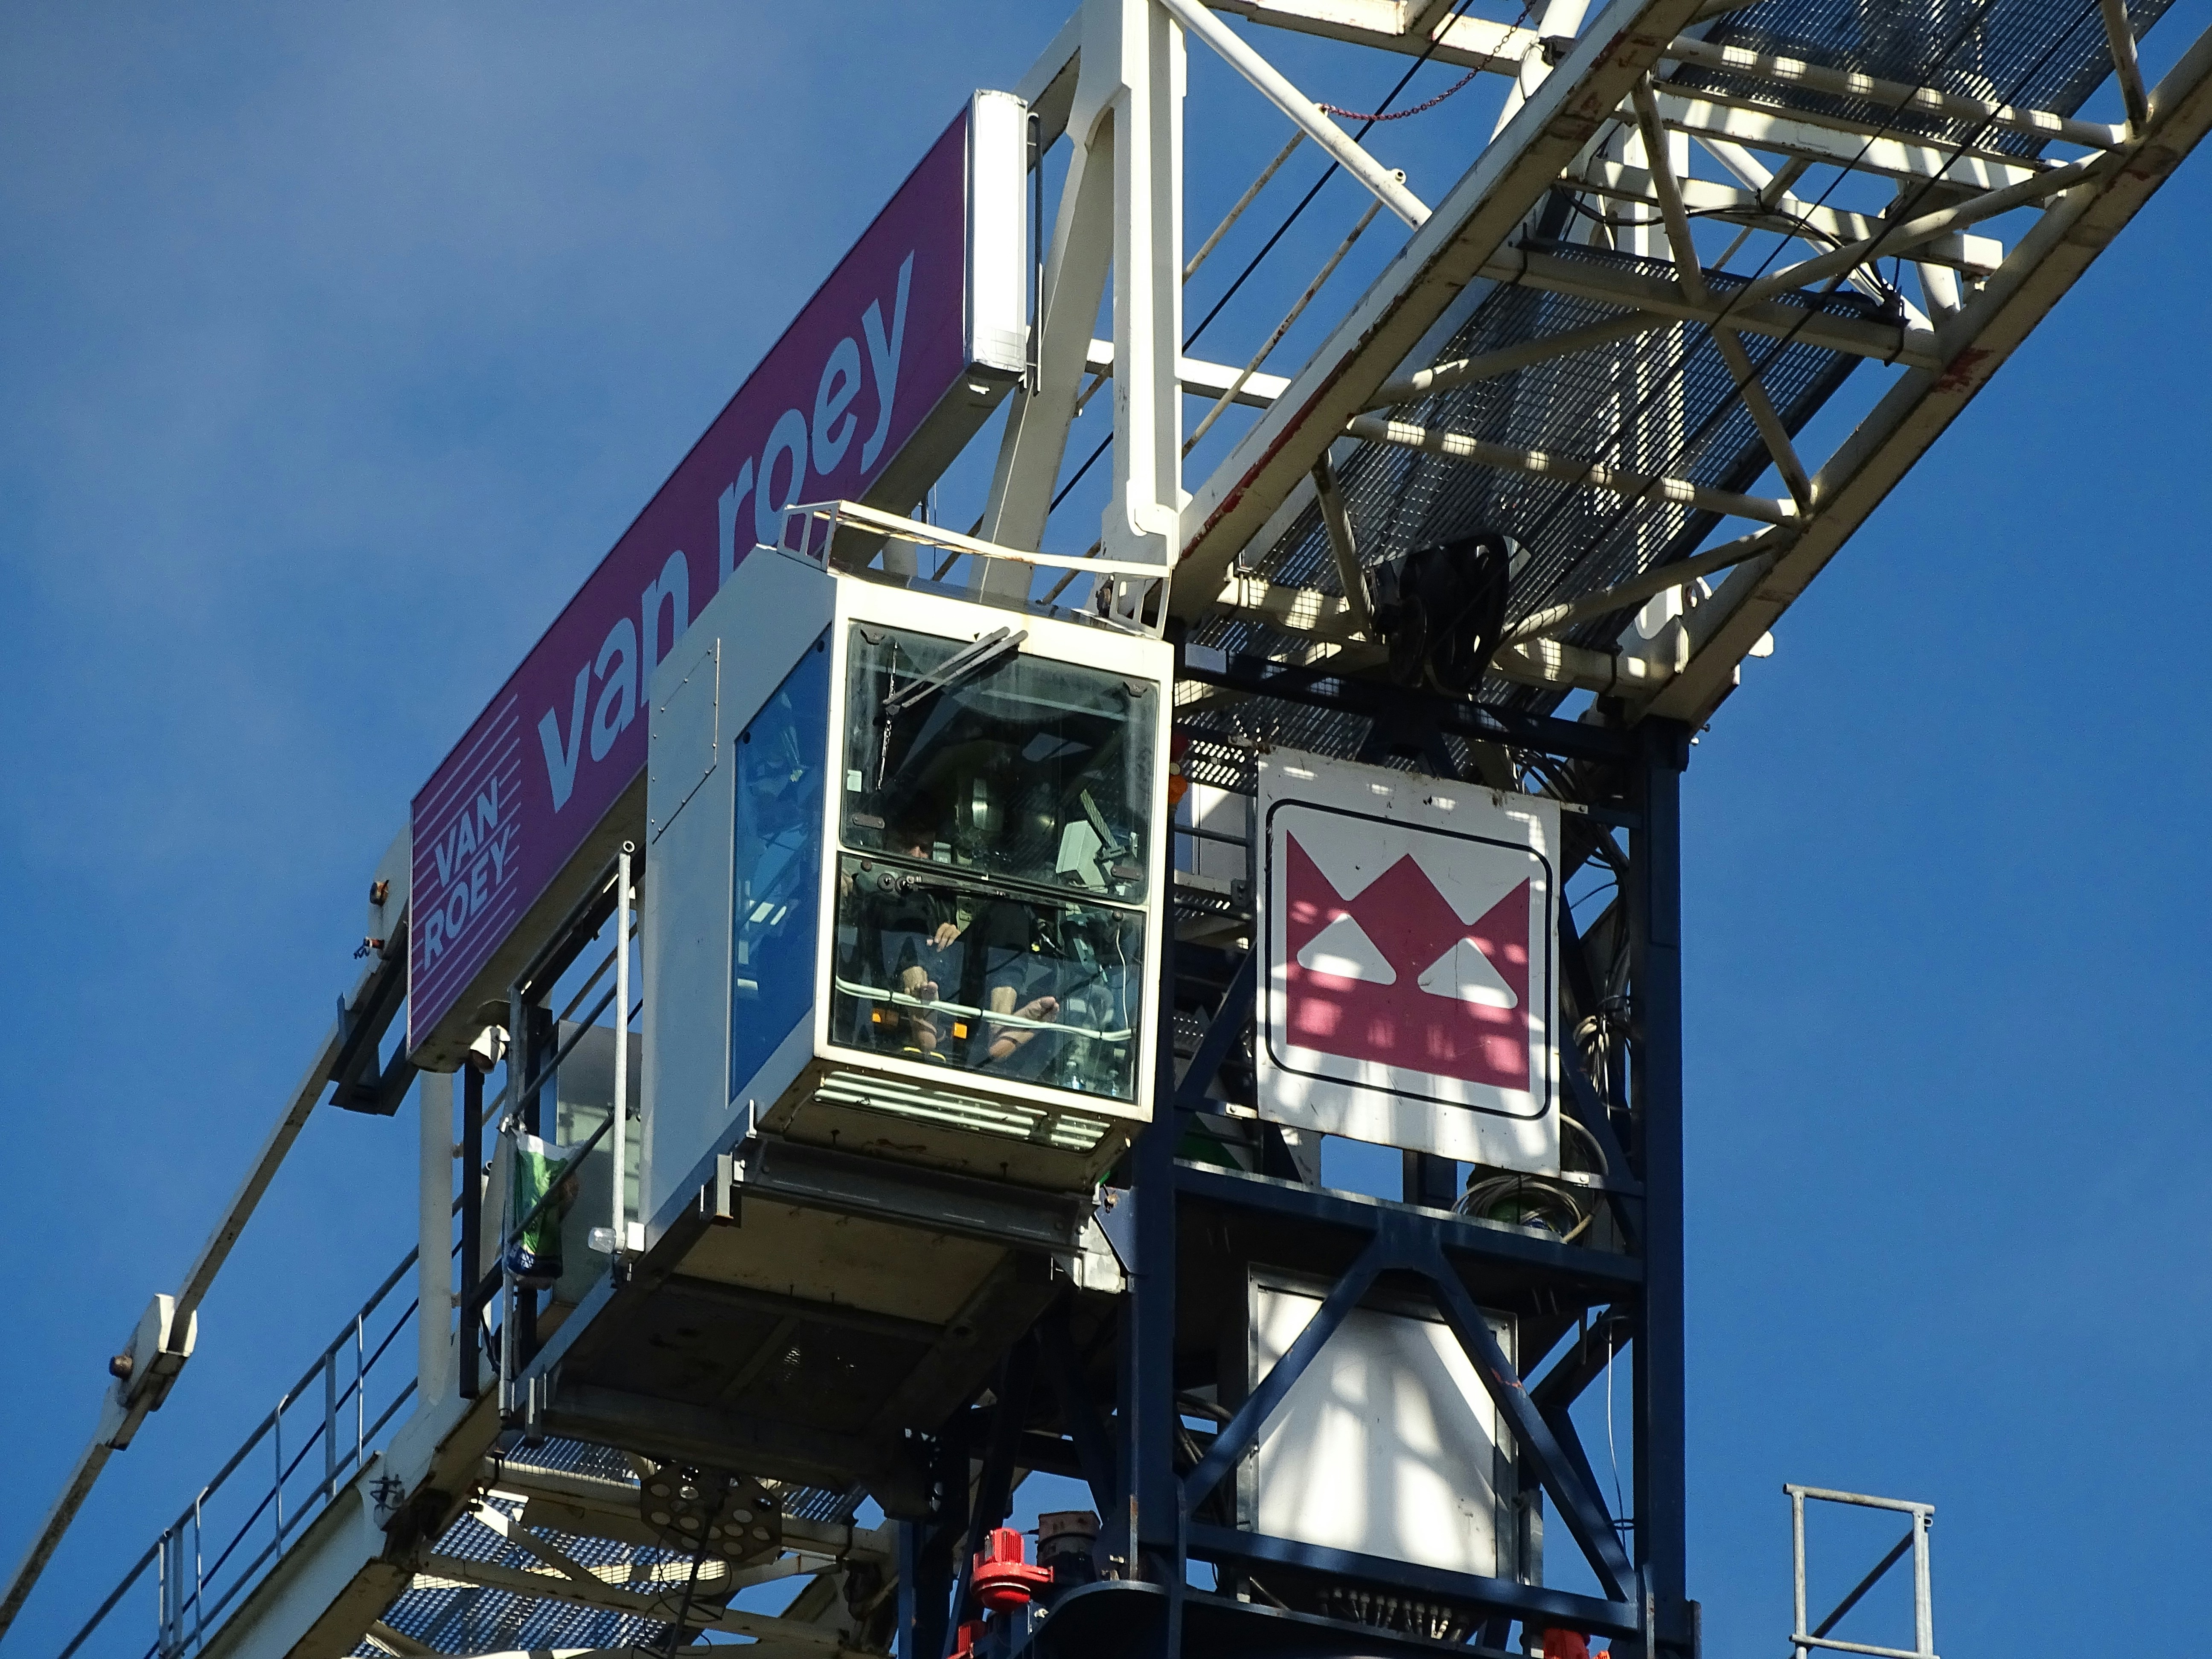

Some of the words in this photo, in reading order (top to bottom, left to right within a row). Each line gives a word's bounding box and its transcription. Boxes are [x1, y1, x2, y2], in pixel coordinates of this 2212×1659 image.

[538, 550, 689, 813] van
[718, 249, 914, 592] roey
[424, 824, 511, 972] ROEY
[434, 776, 498, 888] VAN
